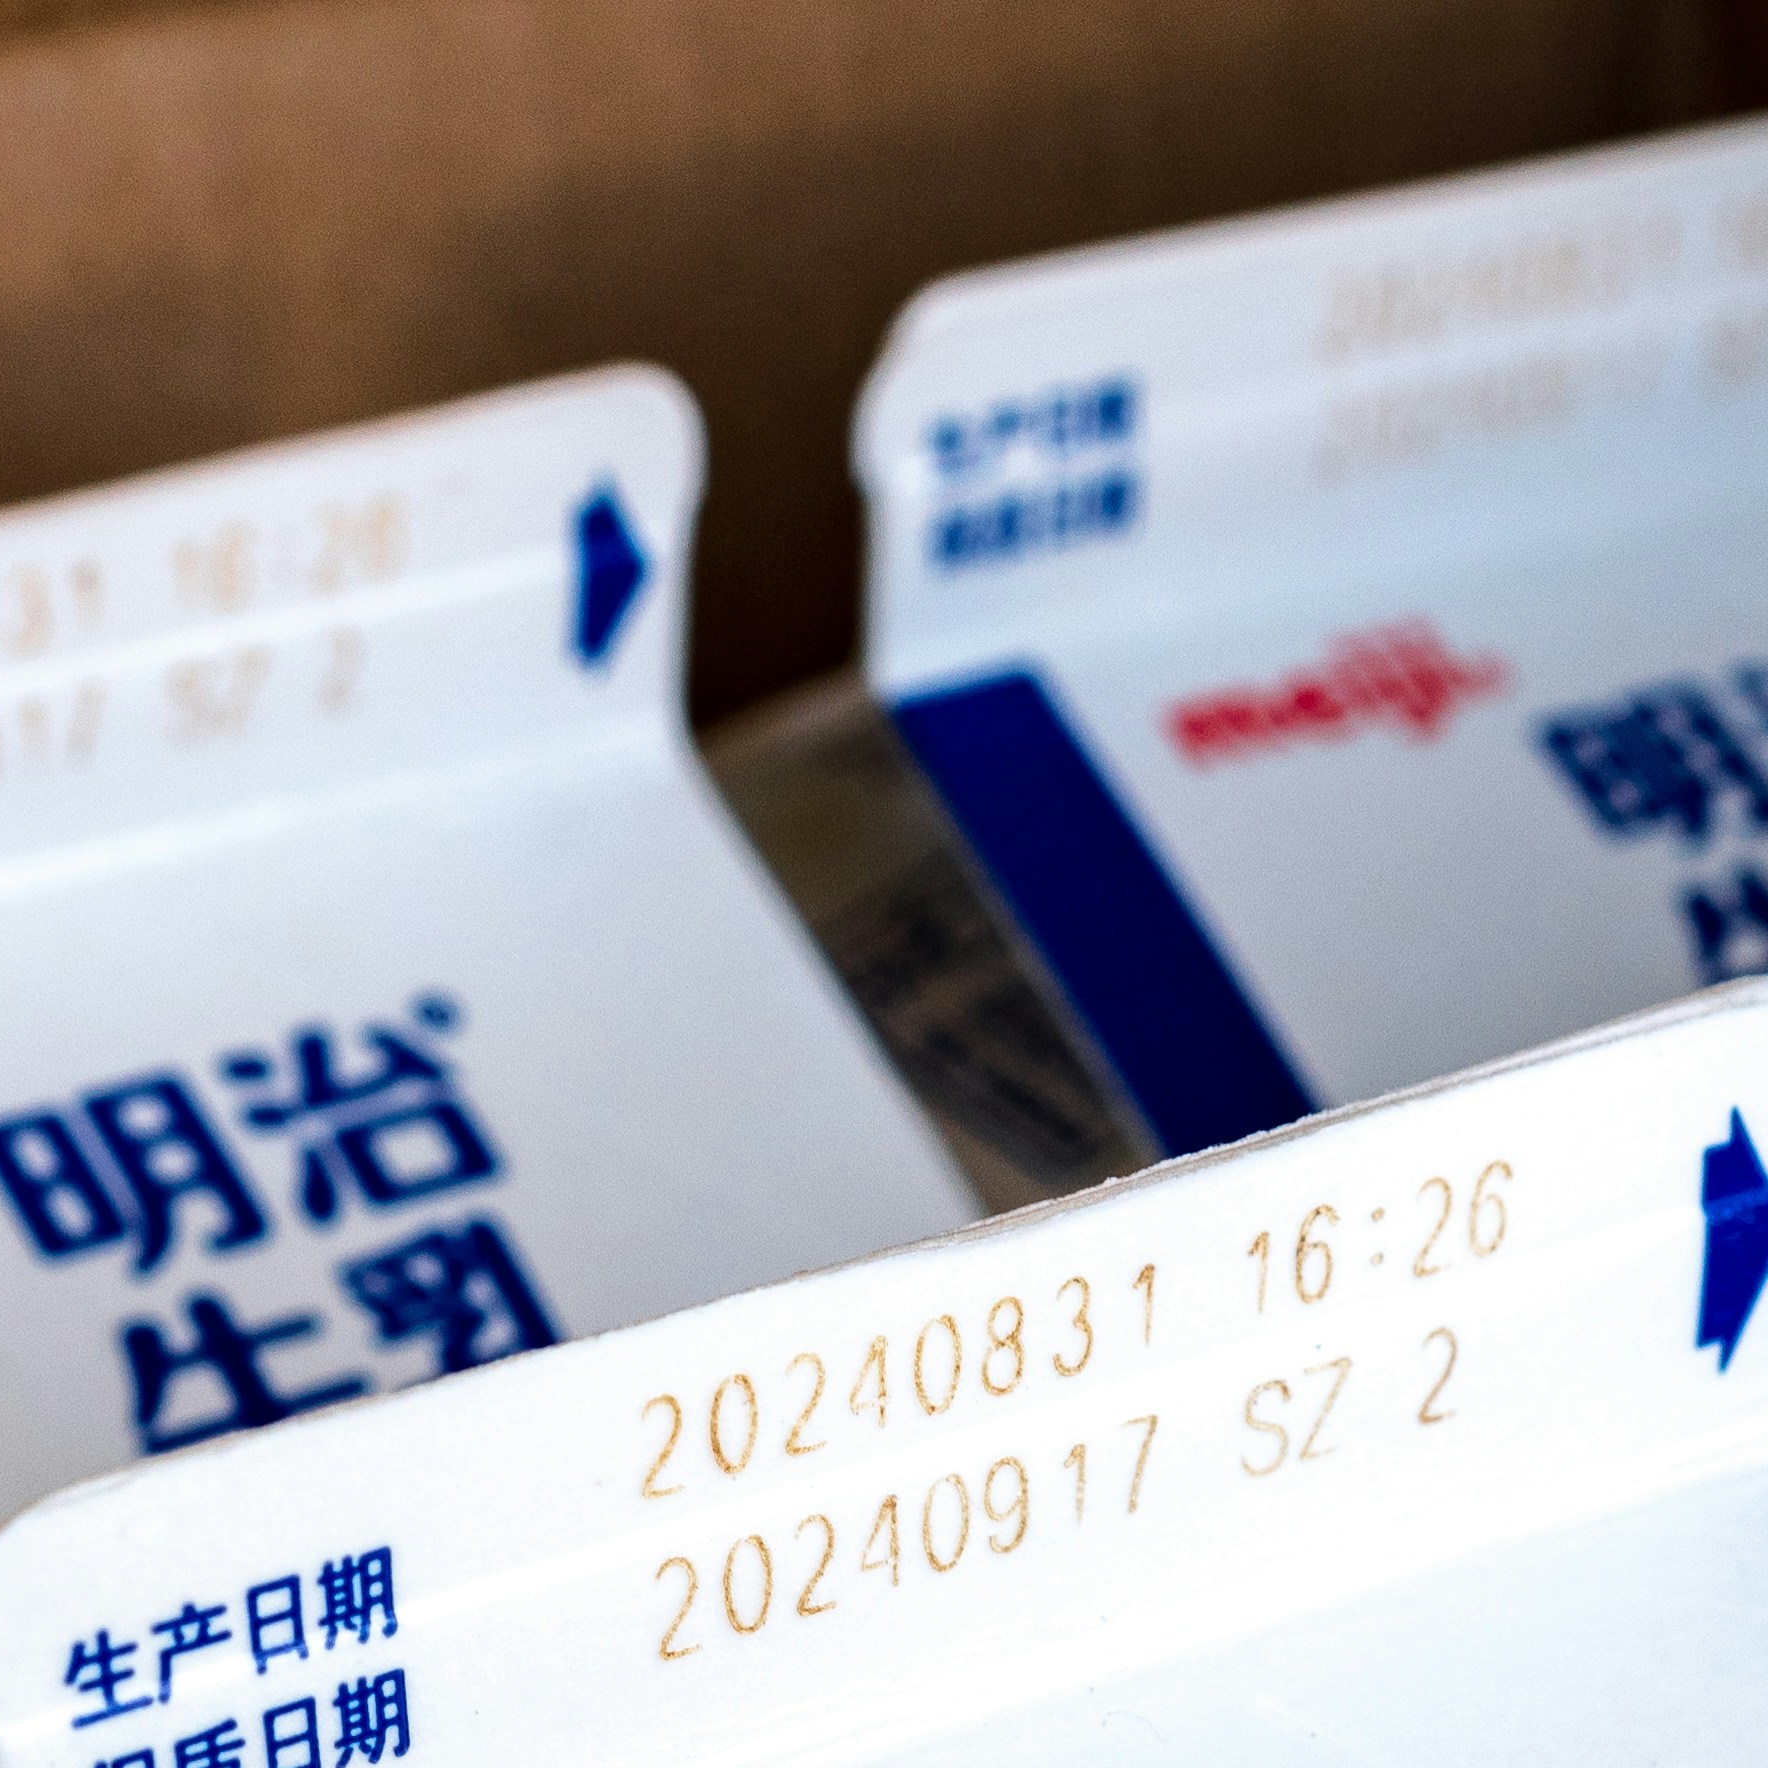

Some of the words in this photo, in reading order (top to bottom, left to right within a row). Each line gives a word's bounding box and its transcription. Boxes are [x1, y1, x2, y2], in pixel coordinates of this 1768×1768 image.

[640, 1262, 1157, 1500] 20240831
[1245, 1159, 1514, 1315] 16:26
[654, 1413, 1159, 1663] 20240917
[1240, 1354, 1355, 1479] SZ
[1415, 1325, 1460, 1426] 2
[63, 1545, 399, 1729] 生产日期
